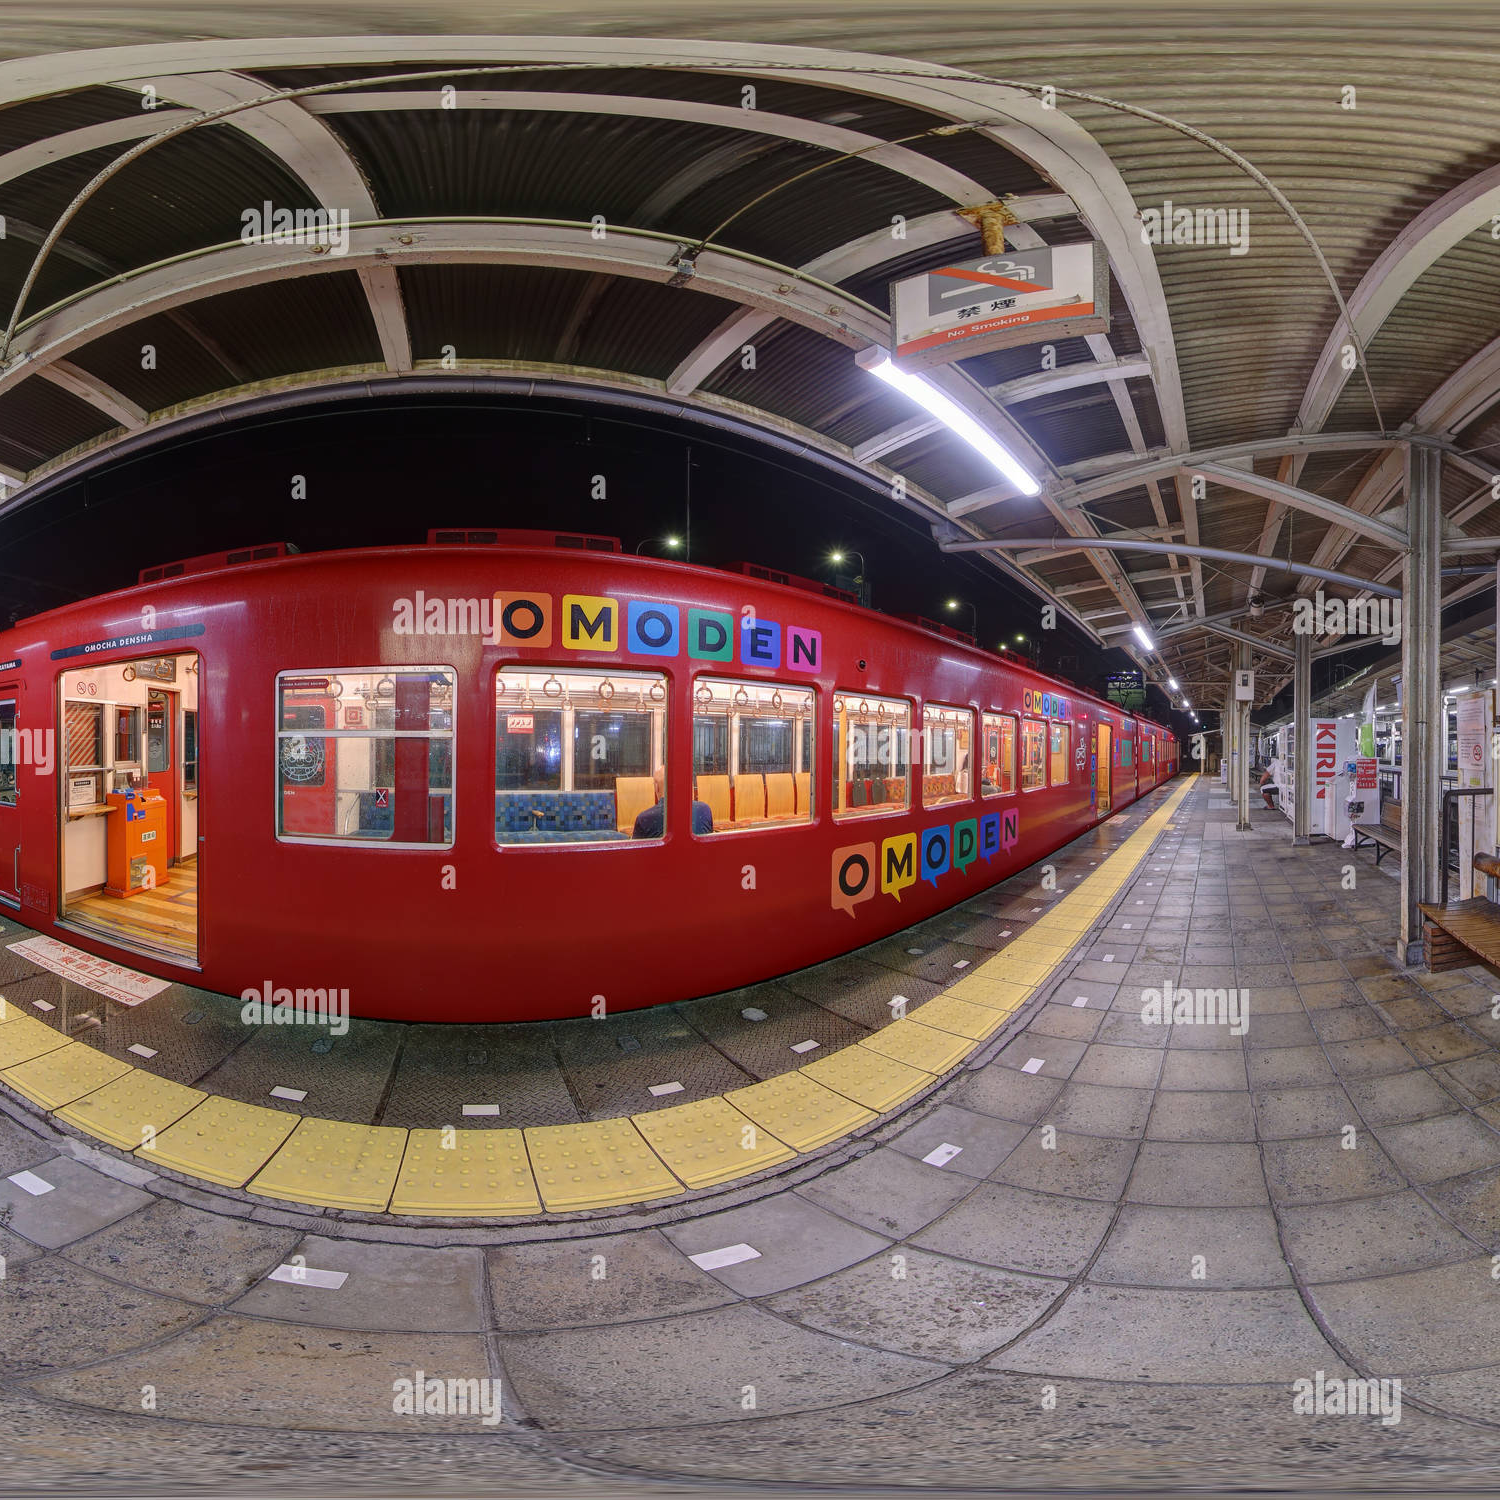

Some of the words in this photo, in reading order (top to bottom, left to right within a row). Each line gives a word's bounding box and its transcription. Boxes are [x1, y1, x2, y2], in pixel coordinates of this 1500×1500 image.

[957, 298, 1016, 319] 禁煙
[948, 328, 965, 338] No
[971, 314, 1030, 332] Smoking
[84, 640, 116, 653] OMOCHA
[120, 634, 152, 647] DENSHA
[502, 599, 816, 666] OMODEN
[838, 814, 1016, 896] OMODEN
[85, 980, 133, 1003] Entrance
